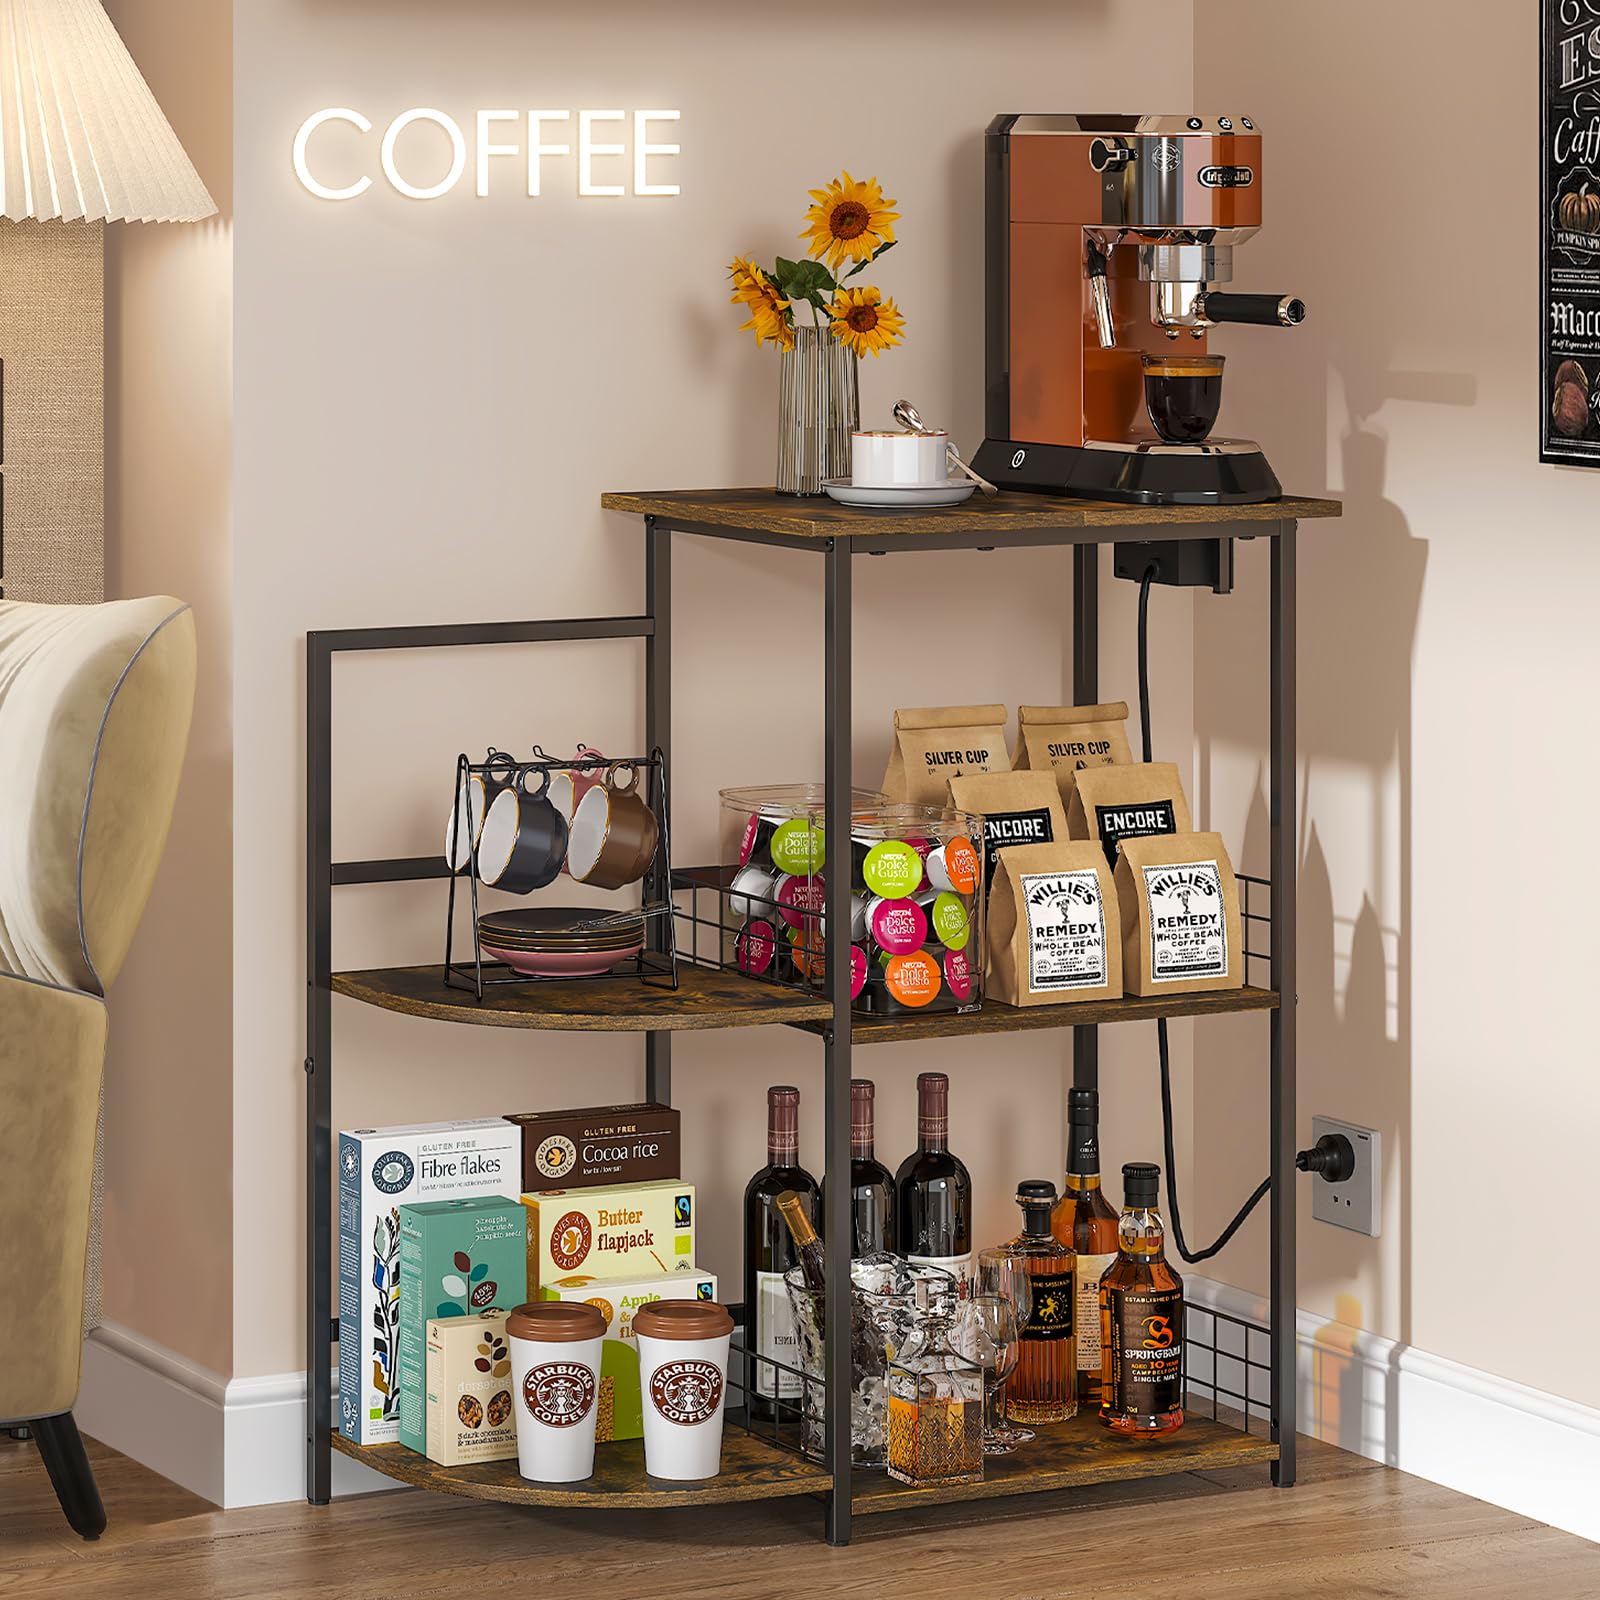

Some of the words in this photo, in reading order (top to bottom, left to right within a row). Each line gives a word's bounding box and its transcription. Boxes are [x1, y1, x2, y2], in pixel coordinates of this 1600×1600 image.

[292, 107, 681, 200] COFFEE
[1048, 743, 1086, 757] SILVER
[1087, 741, 1111, 755] CUP
[925, 751, 964, 766] SILVER
[966, 750, 989, 764] CUP
[1104, 810, 1168, 832] ENCORE
[983, 818, 1045, 840] ENCORE
[877, 860, 909, 870] Dolce
[877, 869, 909, 879] Gusto
[1152, 872, 1217, 897] WILLIE'S
[1030, 881, 1096, 906] WILLIE'S
[886, 915, 916, 926] Dolce
[1157, 914, 1217, 929] REMEDY
[887, 925, 916, 935] Gusto
[1036, 923, 1097, 938] REMEDY
[1156, 932, 1191, 942] WHOLE
[1193, 928, 1221, 938] BEAN
[1034, 941, 1070, 952] WHOLE
[1072, 937, 1101, 948] BEAN
[1171, 939, 1206, 948] COFFEE
[1050, 948, 1086, 957] COFFEE
[900, 968, 930, 979] Dolce
[900, 978, 930, 987] Gusto
[583, 1127, 615, 1137] GLUTEN
[617, 1125, 637, 1134] FREE
[422, 1142, 454, 1152] GLUTEN
[456, 1140, 477, 1149] FREE
[582, 1144, 629, 1164] Cocoa
[632, 1140, 659, 1159] rice
[421, 1159, 457, 1179] Fibre
[460, 1154, 501, 1176] flakes
[597, 1209, 643, 1228] Butter
[597, 1229, 654, 1254] flapjack
[1124, 1295, 1170, 1303] ESTABLISHED
[619, 1312, 631, 1323] &
[1149, 1360, 1165, 1369] 10
[526, 1365, 593, 1391] STARBUCKS
[654, 1363, 721, 1388] STARBUCKS
[1133, 1375, 1162, 1383] SINGLE
[534, 1405, 586, 1425] COFFEE
[661, 1404, 714, 1423] COFFEE
